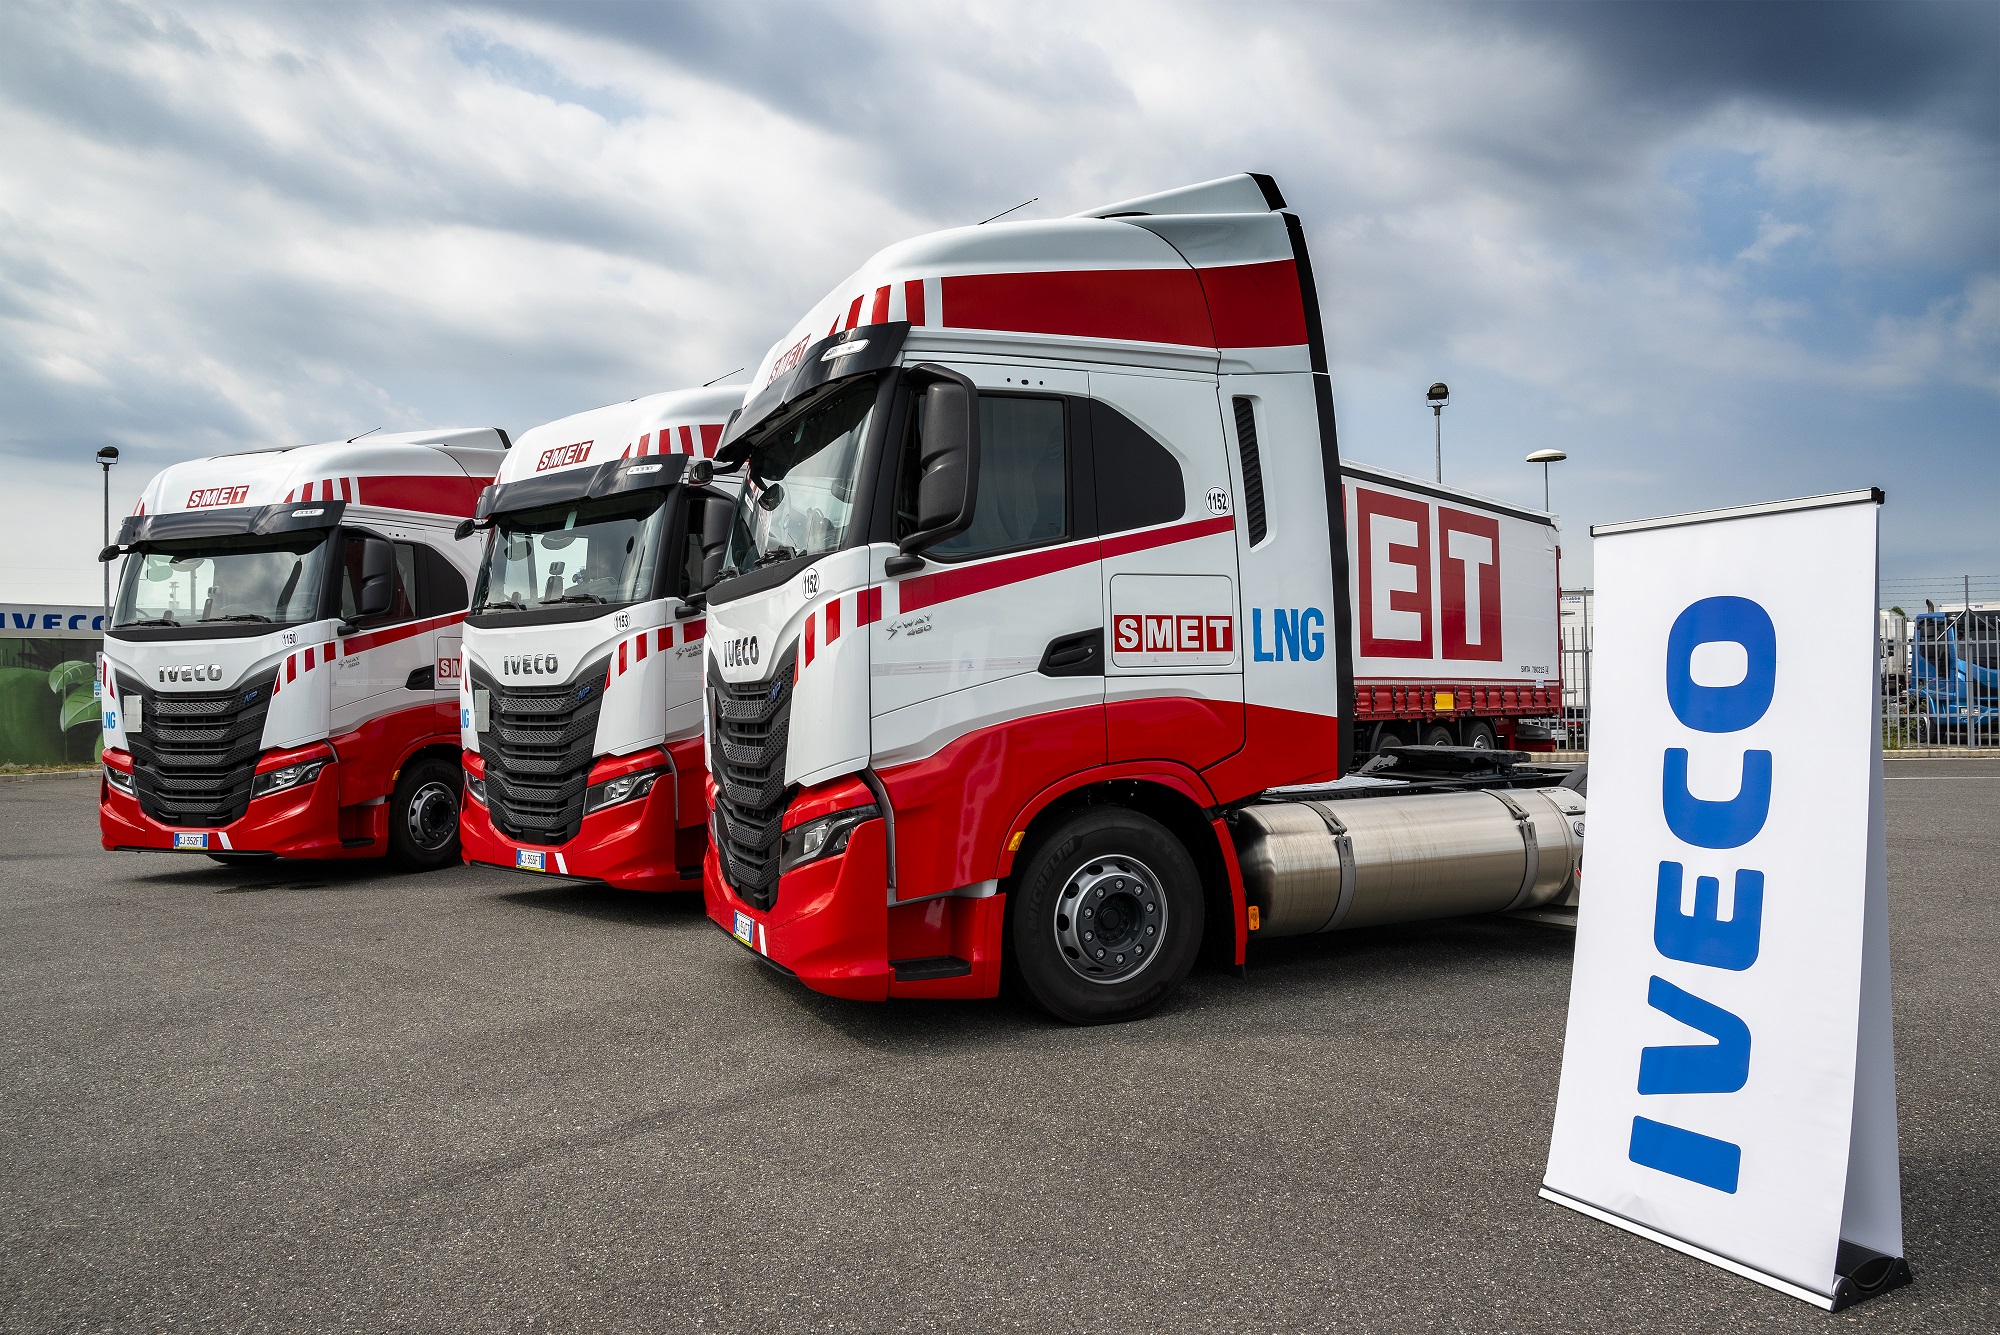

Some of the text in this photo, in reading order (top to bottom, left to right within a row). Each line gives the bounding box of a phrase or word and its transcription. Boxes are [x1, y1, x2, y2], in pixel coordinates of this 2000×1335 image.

[538, 441, 593, 470] SMET
[189, 486, 248, 507] SMET
[1207, 493, 1227, 510] 1152
[803, 574, 817, 594] 1152
[1370, 512, 1493, 646] ET
[614, 615, 629, 628] 1153
[1118, 618, 1230, 649] SMET
[1252, 607, 1325, 662] LNG
[282, 633, 297, 645] 1150
[724, 635, 760, 668] IVECO
[159, 664, 223, 683] IVECO
[503, 653, 559, 676] IVECO
[1028, 838, 1075, 931] MICHELIN
[1629, 595, 1776, 1195] IVECO
